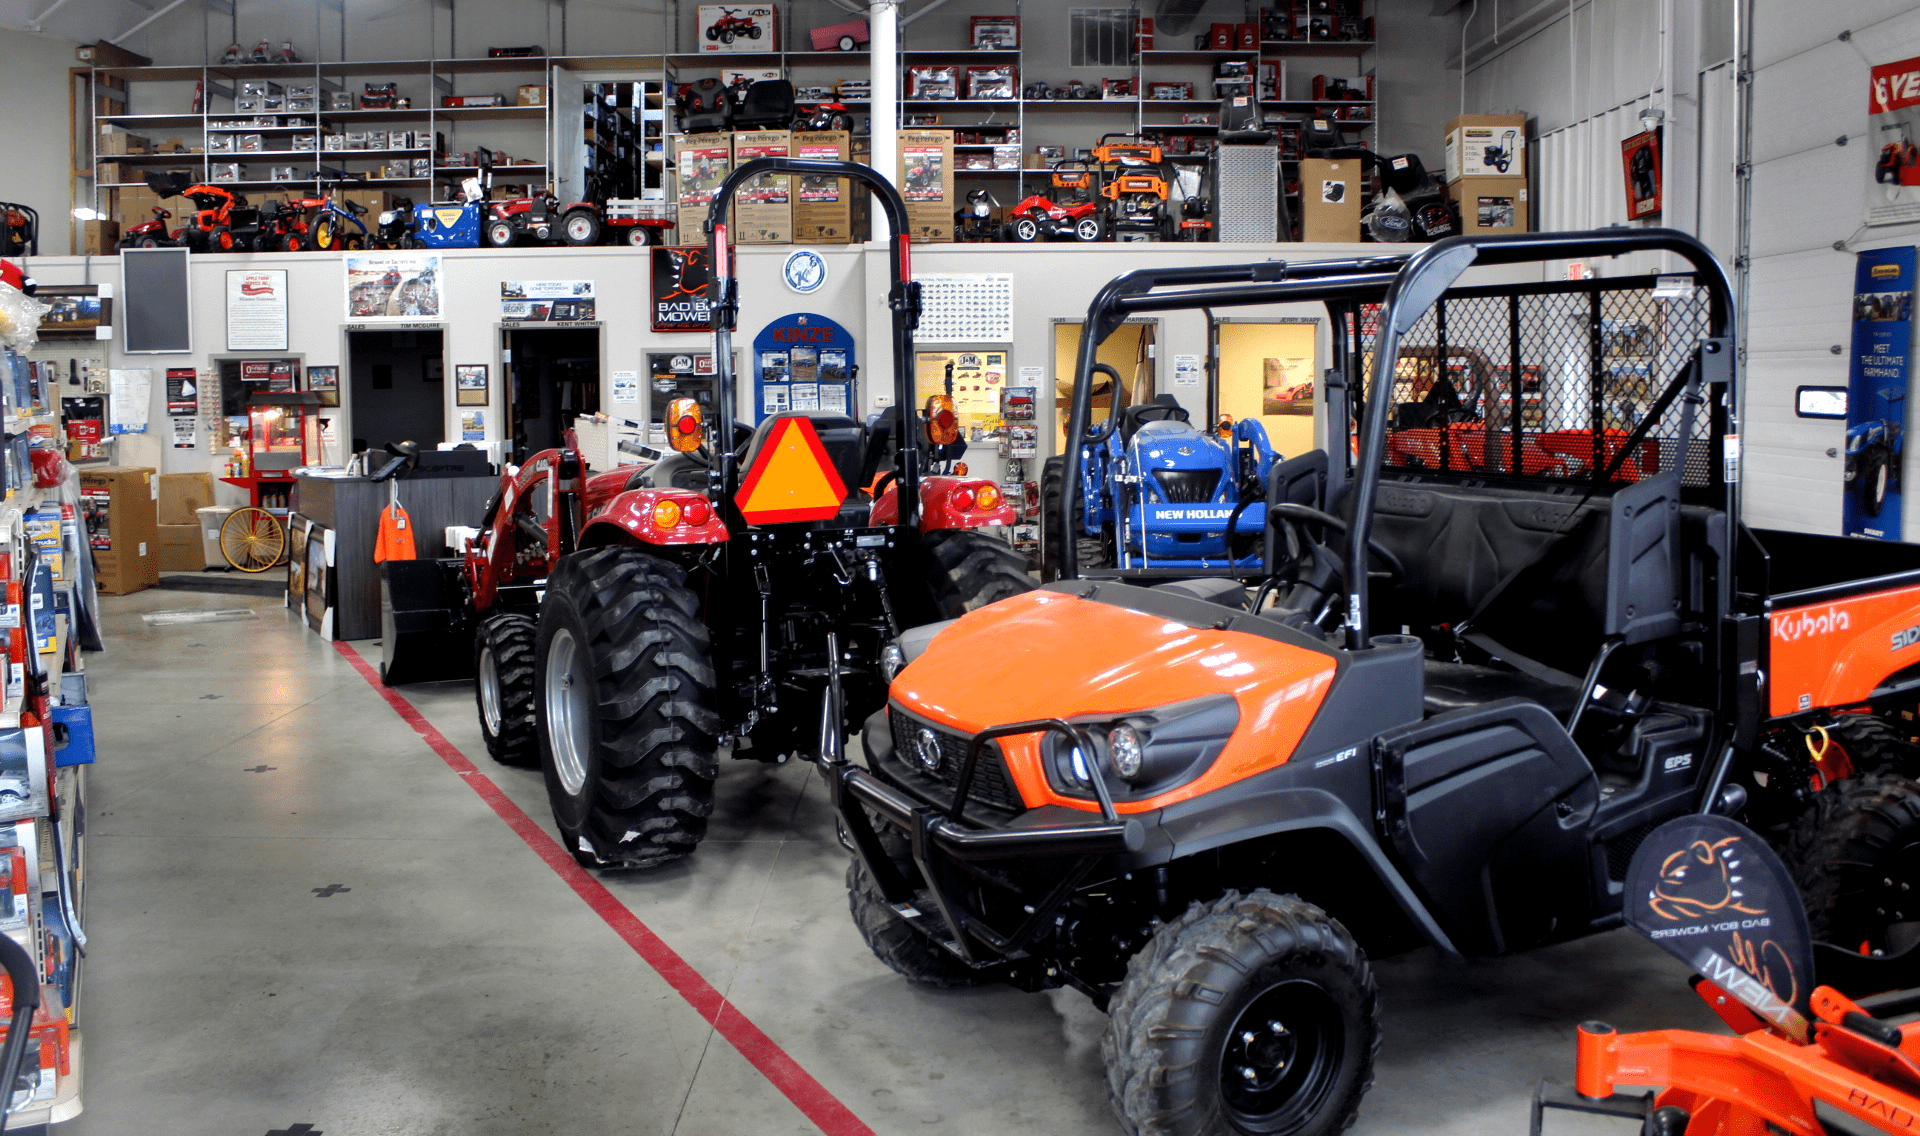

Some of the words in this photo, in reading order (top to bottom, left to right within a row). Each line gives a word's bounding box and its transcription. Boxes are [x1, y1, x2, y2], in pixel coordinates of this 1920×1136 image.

[1875, 77, 1888, 105] 6
[1890, 71, 1920, 101] YE
[745, 134, 779, 142] Peg-Pérego
[802, 134, 837, 142] Peg-Pérego
[658, 302, 691, 312] BAD
[658, 312, 711, 322] MOWE
[773, 327, 834, 343] KINZE
[1873, 343, 1891, 354] MEET
[1861, 355, 1873, 365] THE
[1873, 355, 1904, 366] ULTIMATE
[1155, 509, 1184, 520] NEW
[1186, 509, 1244, 520] HOLLAN
[1773, 606, 1849, 641] Kubota
[1891, 624, 1920, 652] SID
[1336, 747, 1356, 762] EFI
[1664, 753, 1692, 770] EPS
